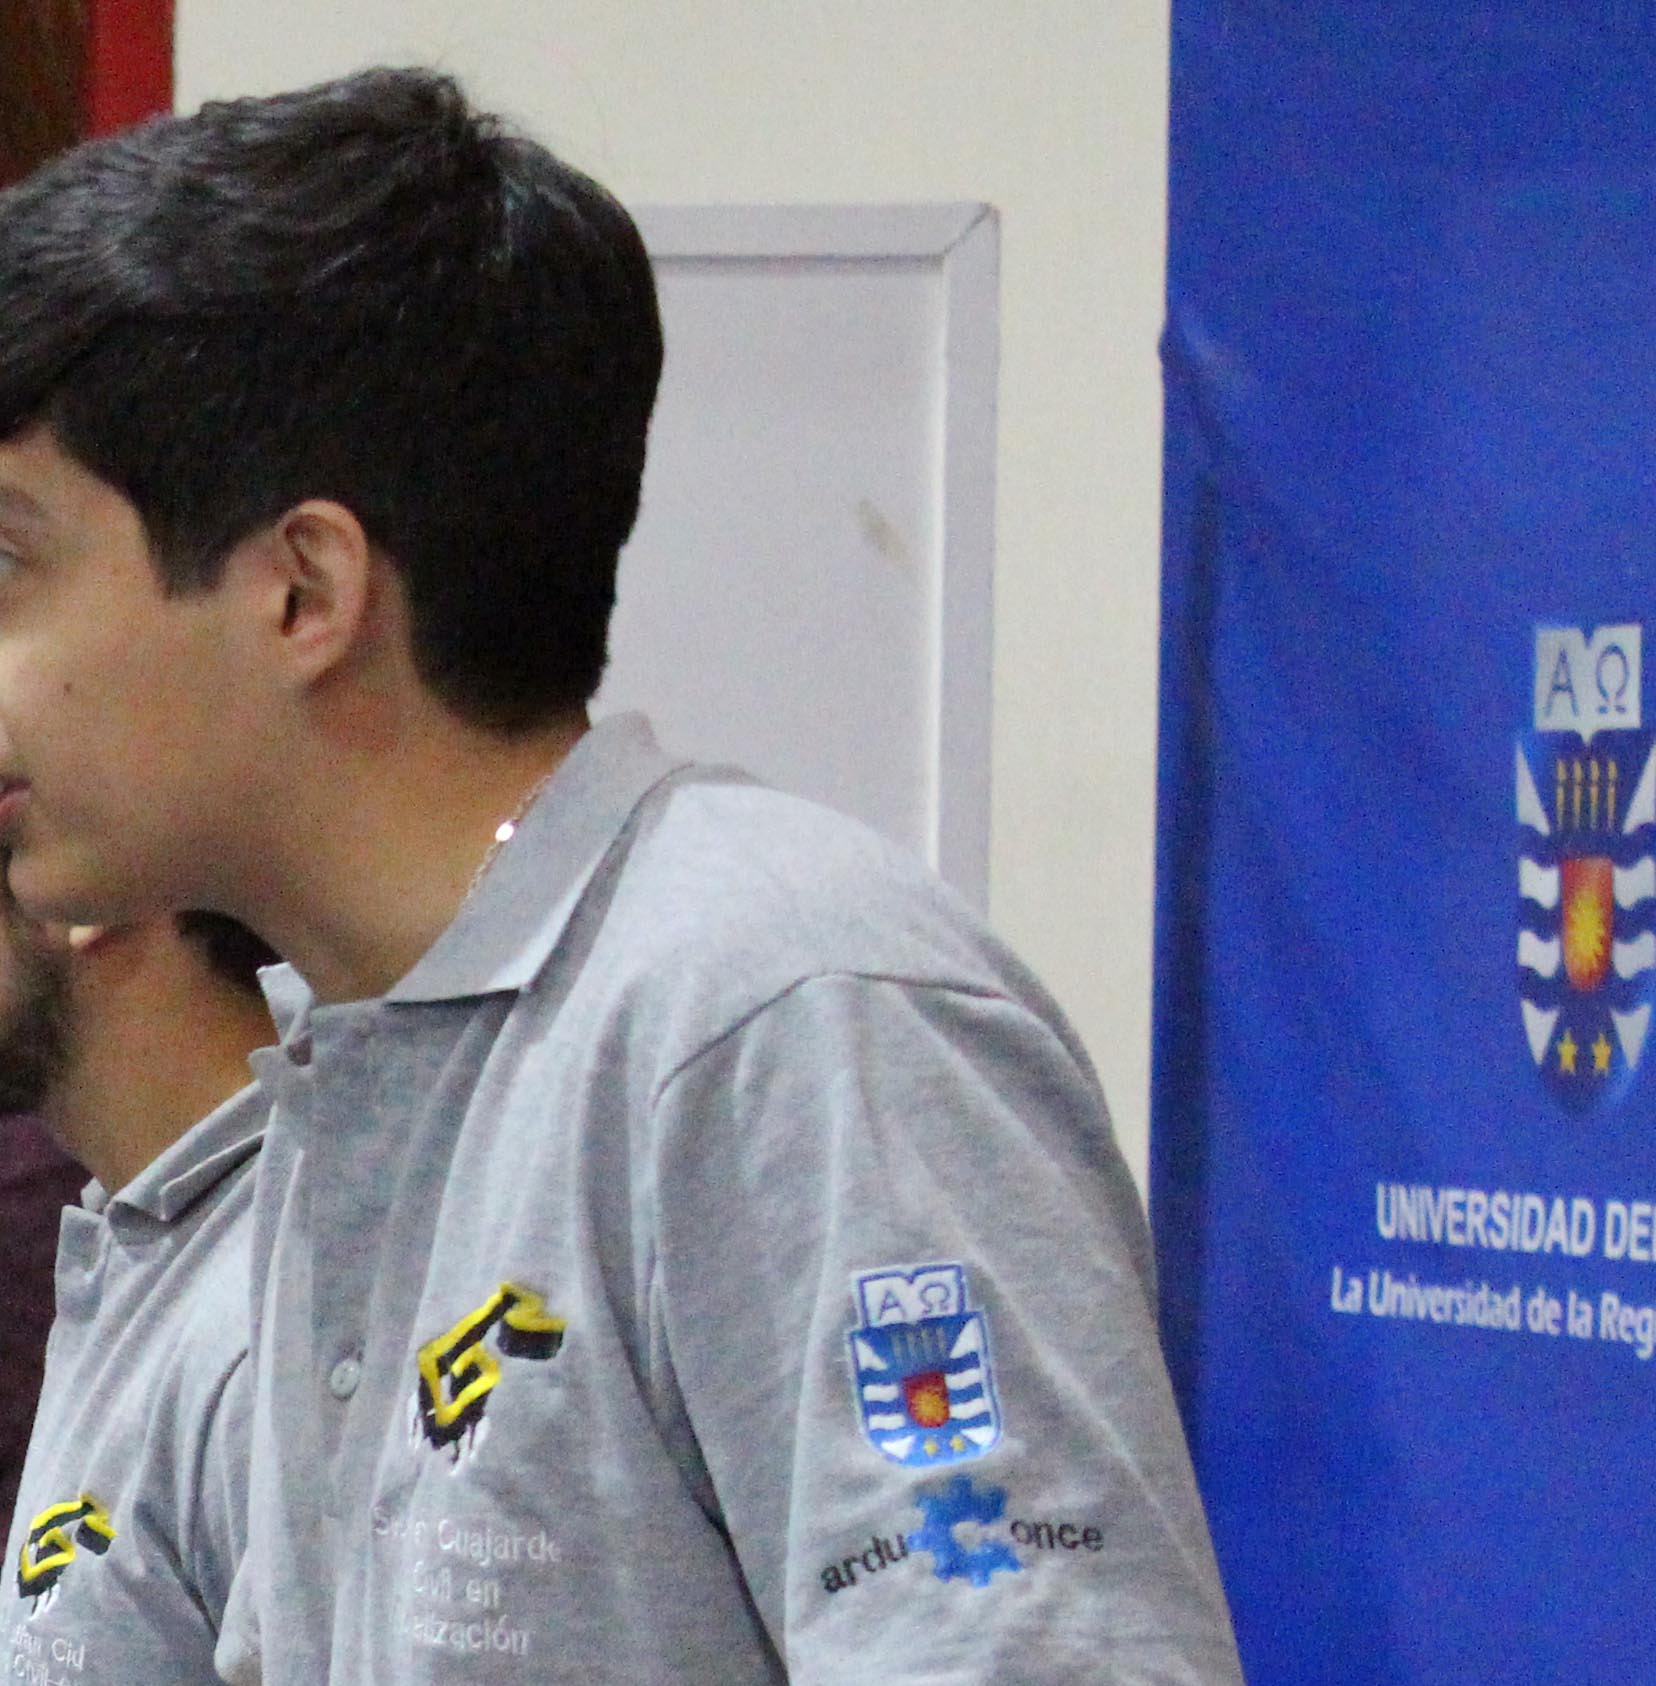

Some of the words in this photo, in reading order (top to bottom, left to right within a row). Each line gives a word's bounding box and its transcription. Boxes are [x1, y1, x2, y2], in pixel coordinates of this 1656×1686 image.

[1376, 1182, 1596, 1257] UNIVERSIDAD
[1603, 1200, 1656, 1263] DE
[1330, 1266, 1364, 1315] La
[1368, 1268, 1522, 1332] Universidad
[1526, 1285, 1562, 1336] de
[1567, 1289, 1593, 1340] la
[819, 1532, 912, 1595] ardu
[1008, 1517, 1106, 1553] once
[464, 1577, 502, 1610] en
[50, 1637, 86, 1673] Cid
